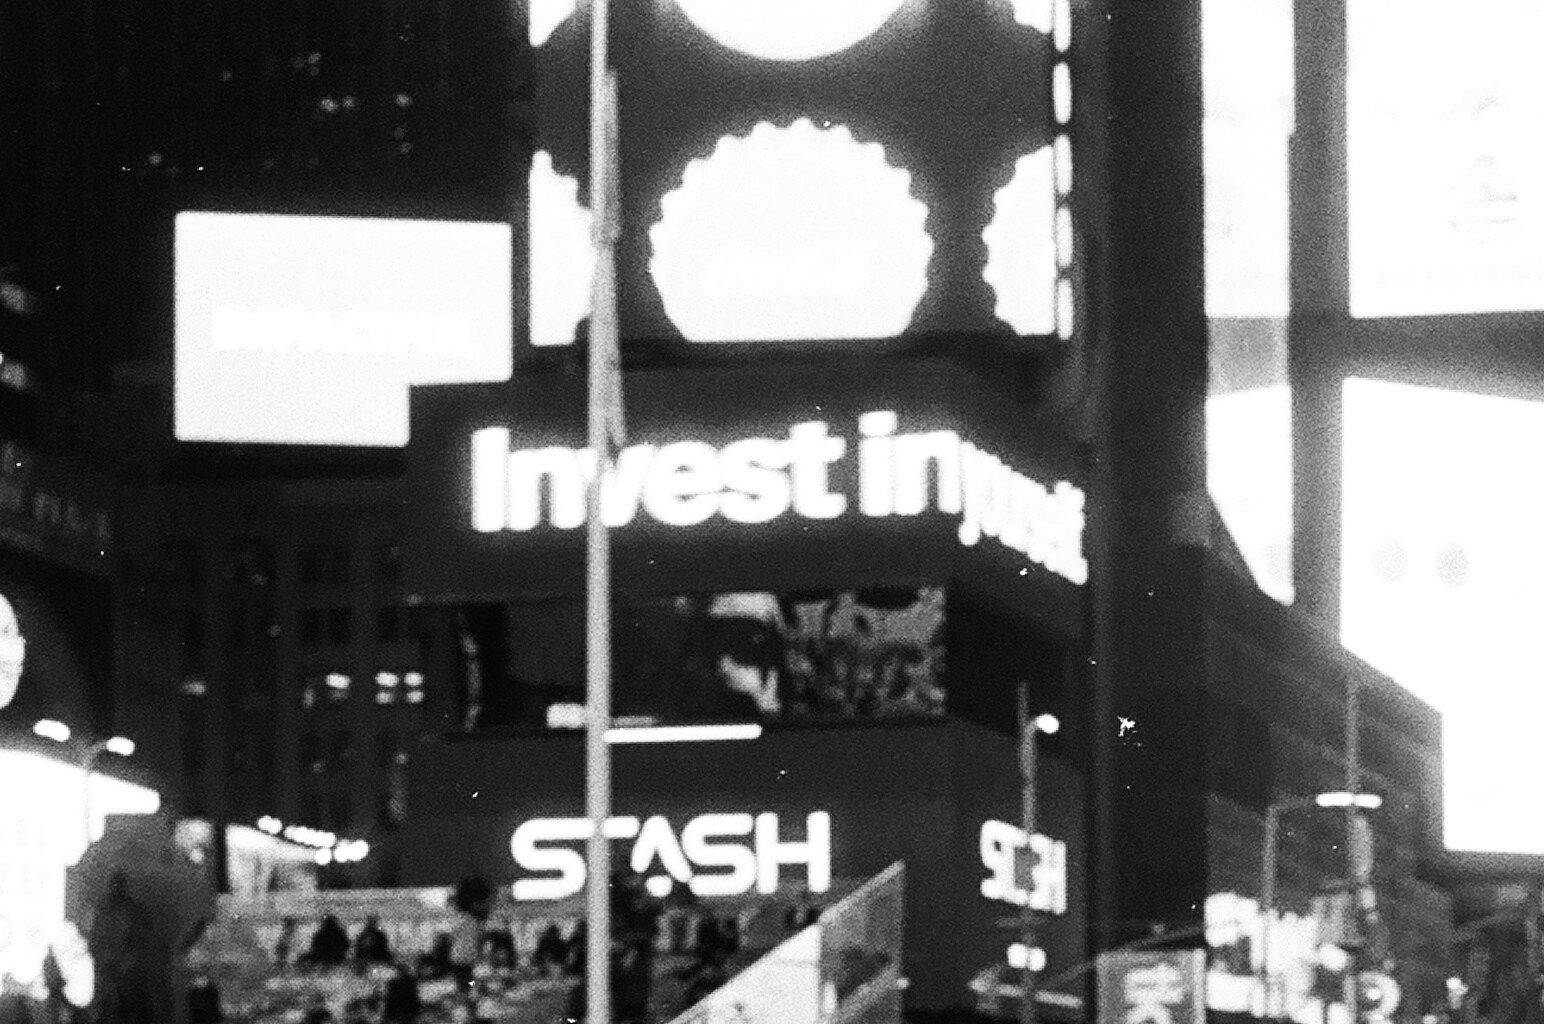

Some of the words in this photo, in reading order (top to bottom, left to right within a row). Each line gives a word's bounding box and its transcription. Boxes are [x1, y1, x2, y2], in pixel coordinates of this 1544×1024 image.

[472, 421, 846, 531] Invest
[857, 410, 961, 516] in
[511, 811, 831, 901] STASH
